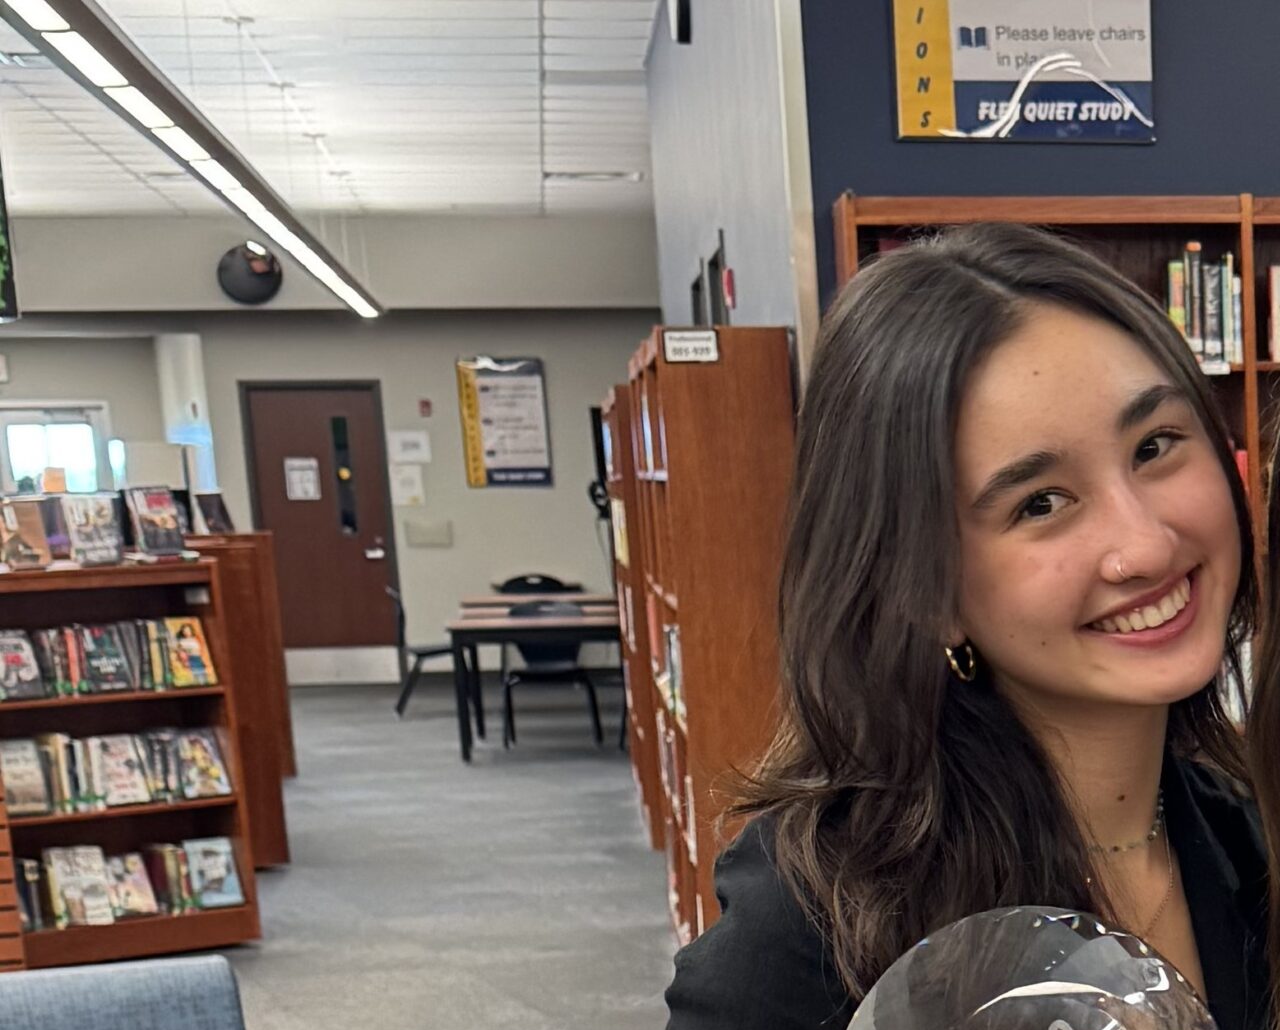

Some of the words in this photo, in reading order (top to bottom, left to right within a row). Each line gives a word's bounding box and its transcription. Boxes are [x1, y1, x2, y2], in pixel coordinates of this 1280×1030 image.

[995, 26, 1049, 41] Please
[1053, 26, 1095, 41] leave
[1100, 27, 1147, 41] chairs
[997, 52, 1011, 66] in
[1023, 101, 1077, 123] QUIET
[1078, 101, 1134, 121] STUDY
